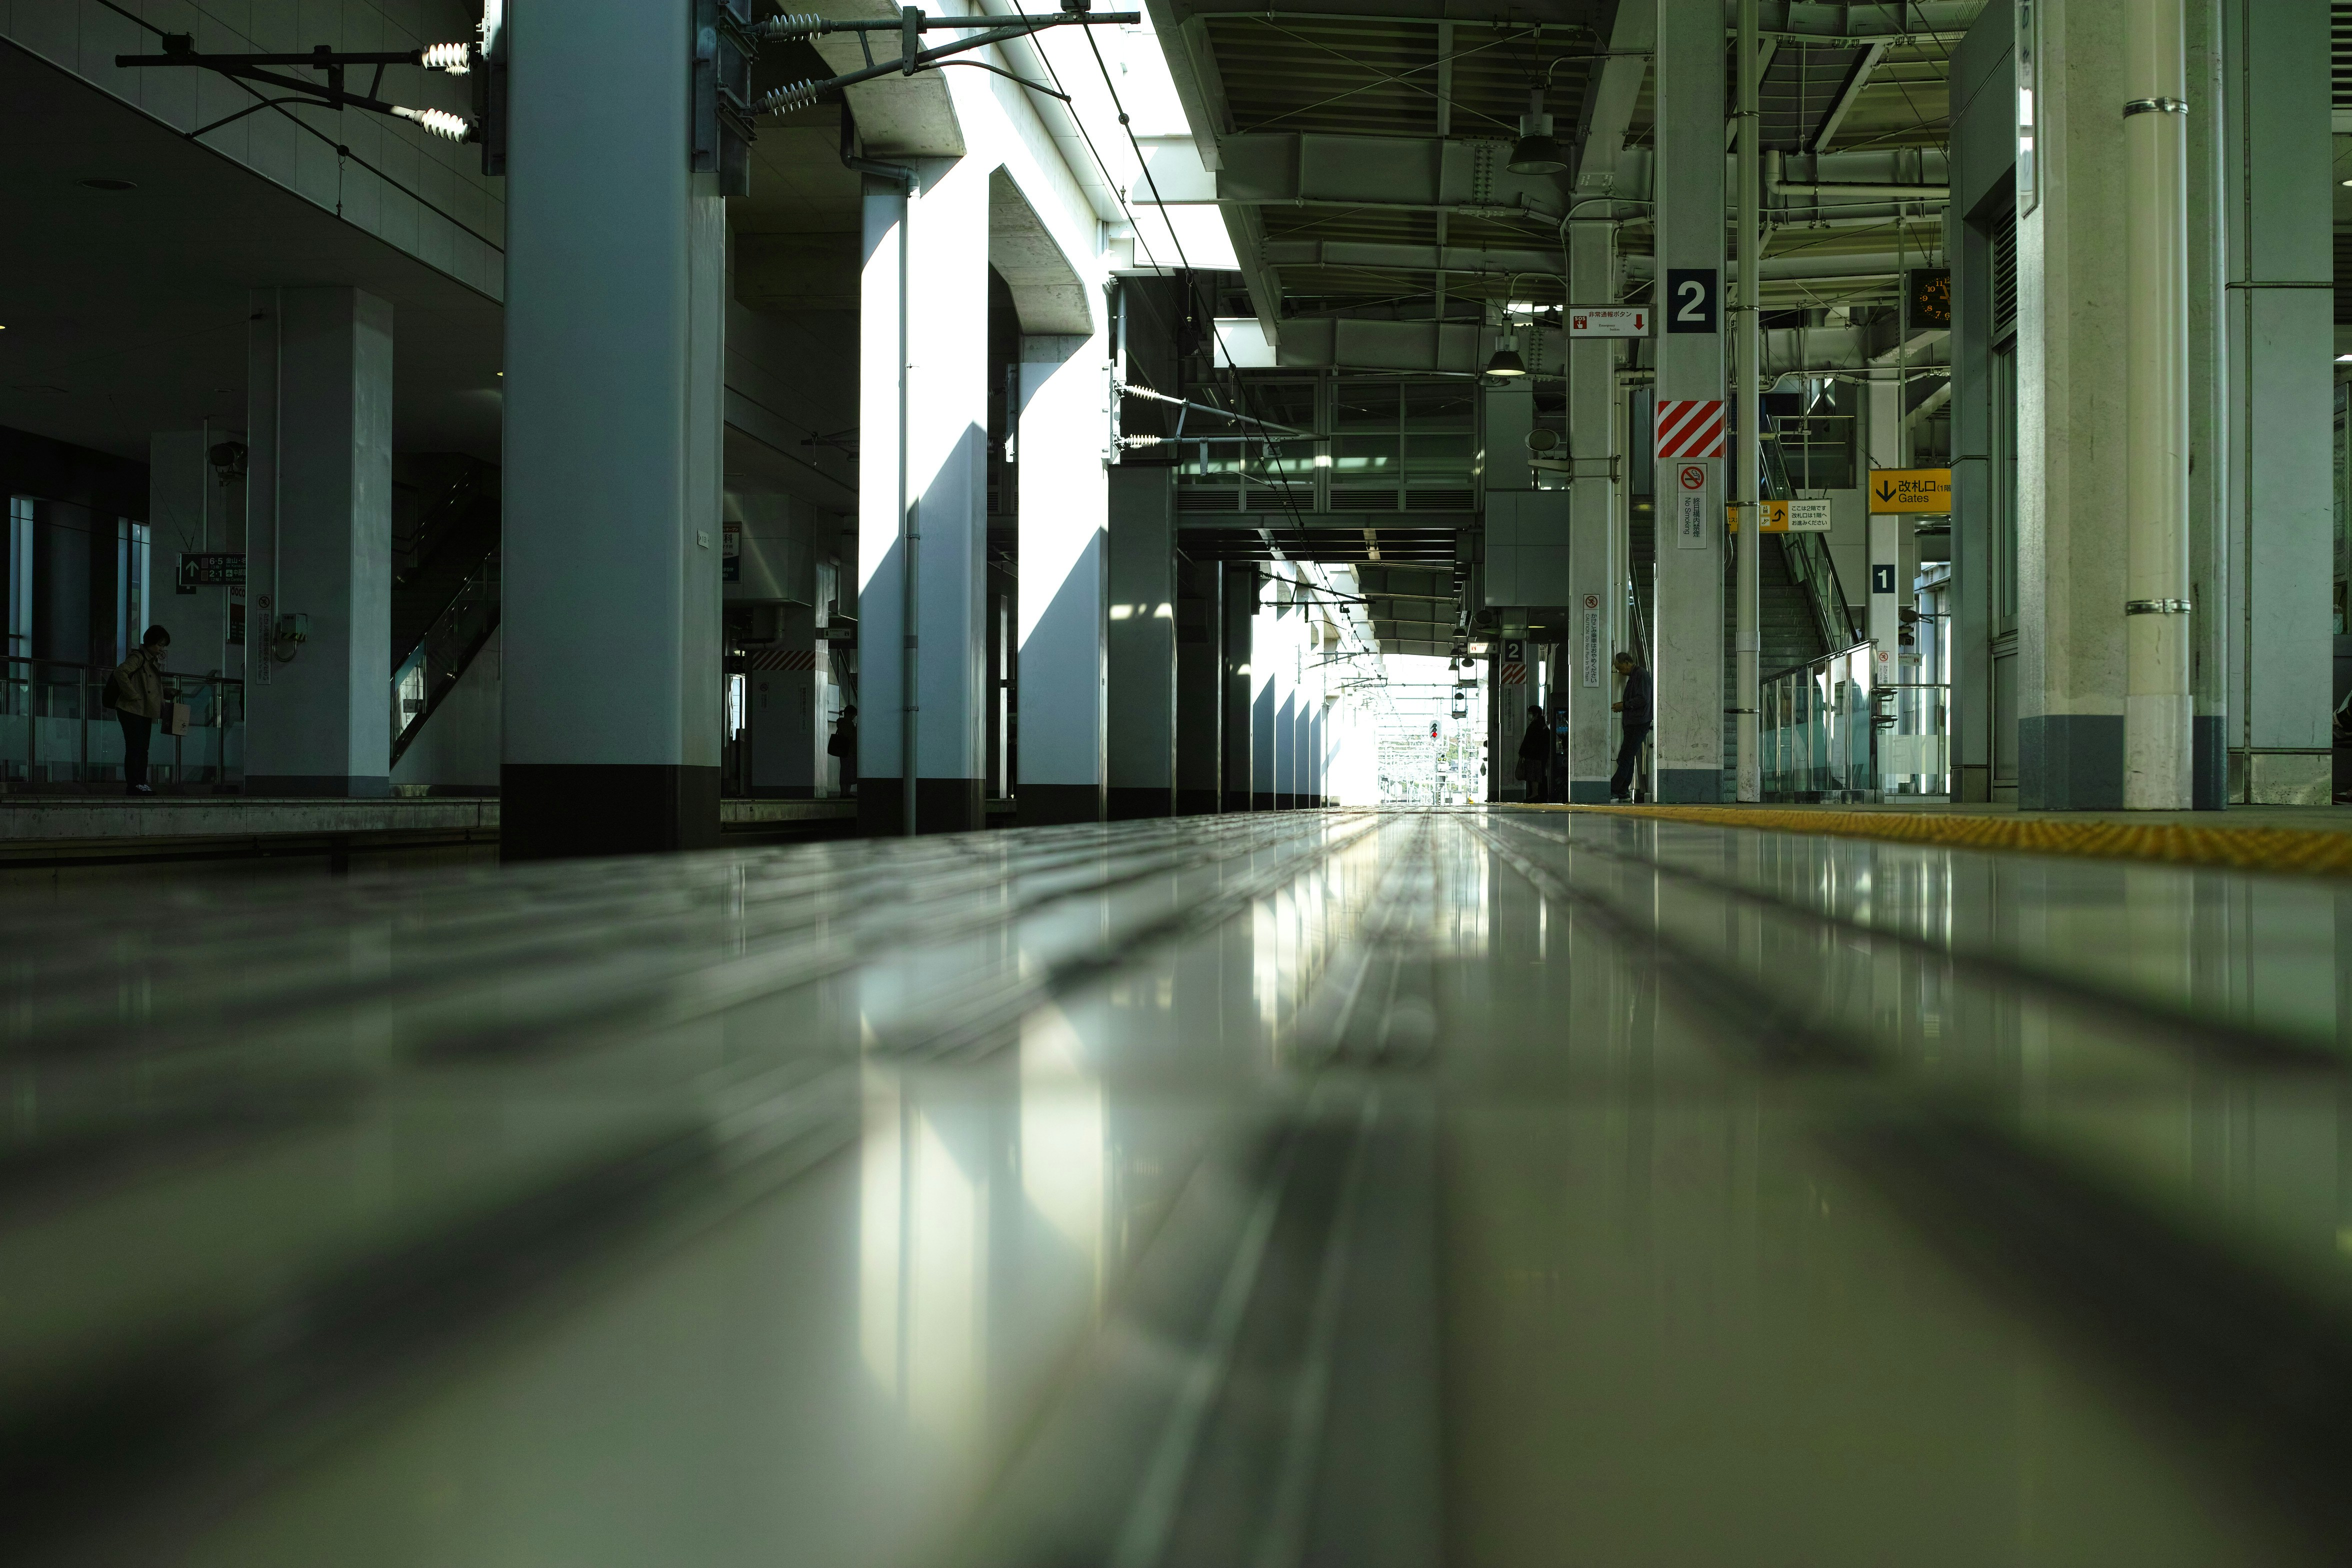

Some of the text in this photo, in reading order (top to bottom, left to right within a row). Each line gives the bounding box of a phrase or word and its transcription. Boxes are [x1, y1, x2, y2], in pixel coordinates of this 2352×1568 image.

[1678, 280, 1705, 321] 2
[1684, 498, 1691, 506] No
[1899, 494, 1929, 502] Gates
[1878, 570, 1886, 588] 1
[1508, 644, 1519, 658] 2
